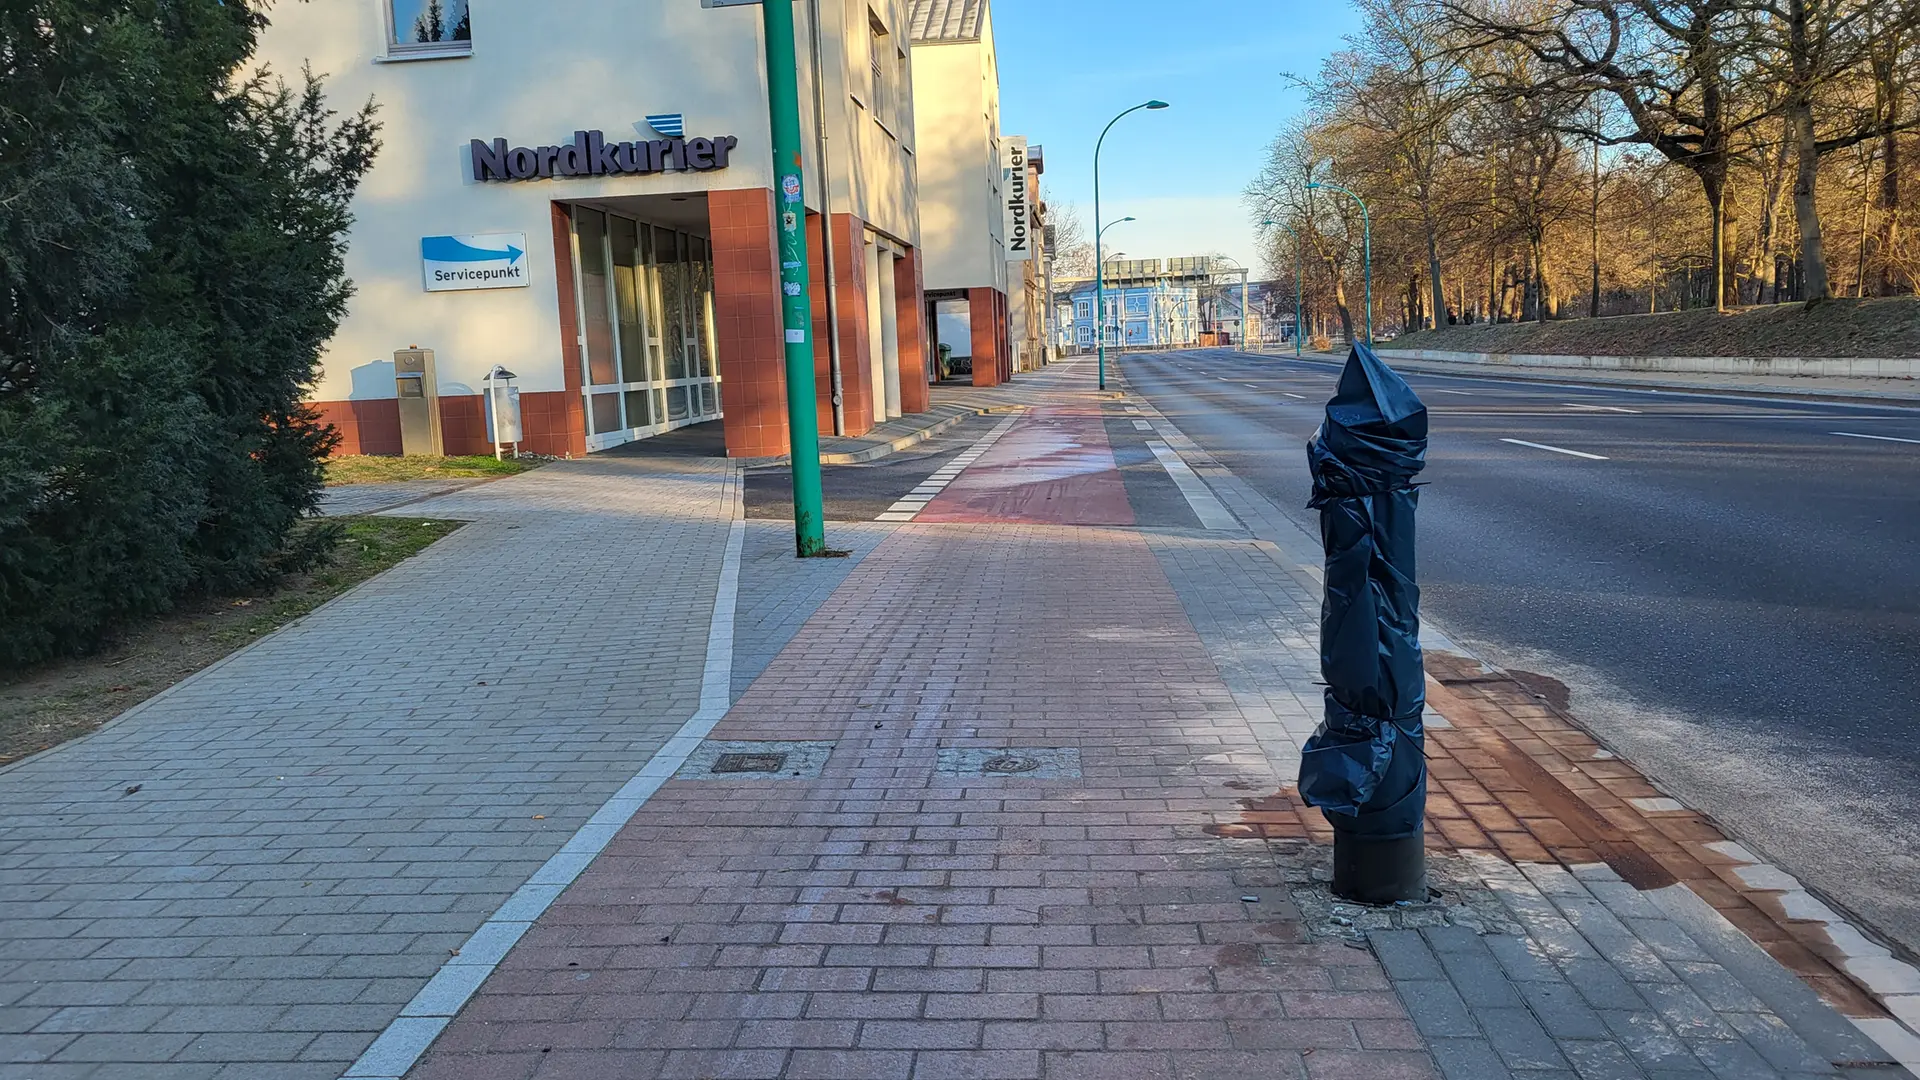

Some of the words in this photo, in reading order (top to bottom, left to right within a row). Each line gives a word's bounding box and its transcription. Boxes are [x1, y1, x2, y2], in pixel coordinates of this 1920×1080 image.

[471, 129, 738, 181] Nordkurier
[1008, 146, 1026, 251] Nordkurier
[434, 265, 521, 283] Servicepunkt
